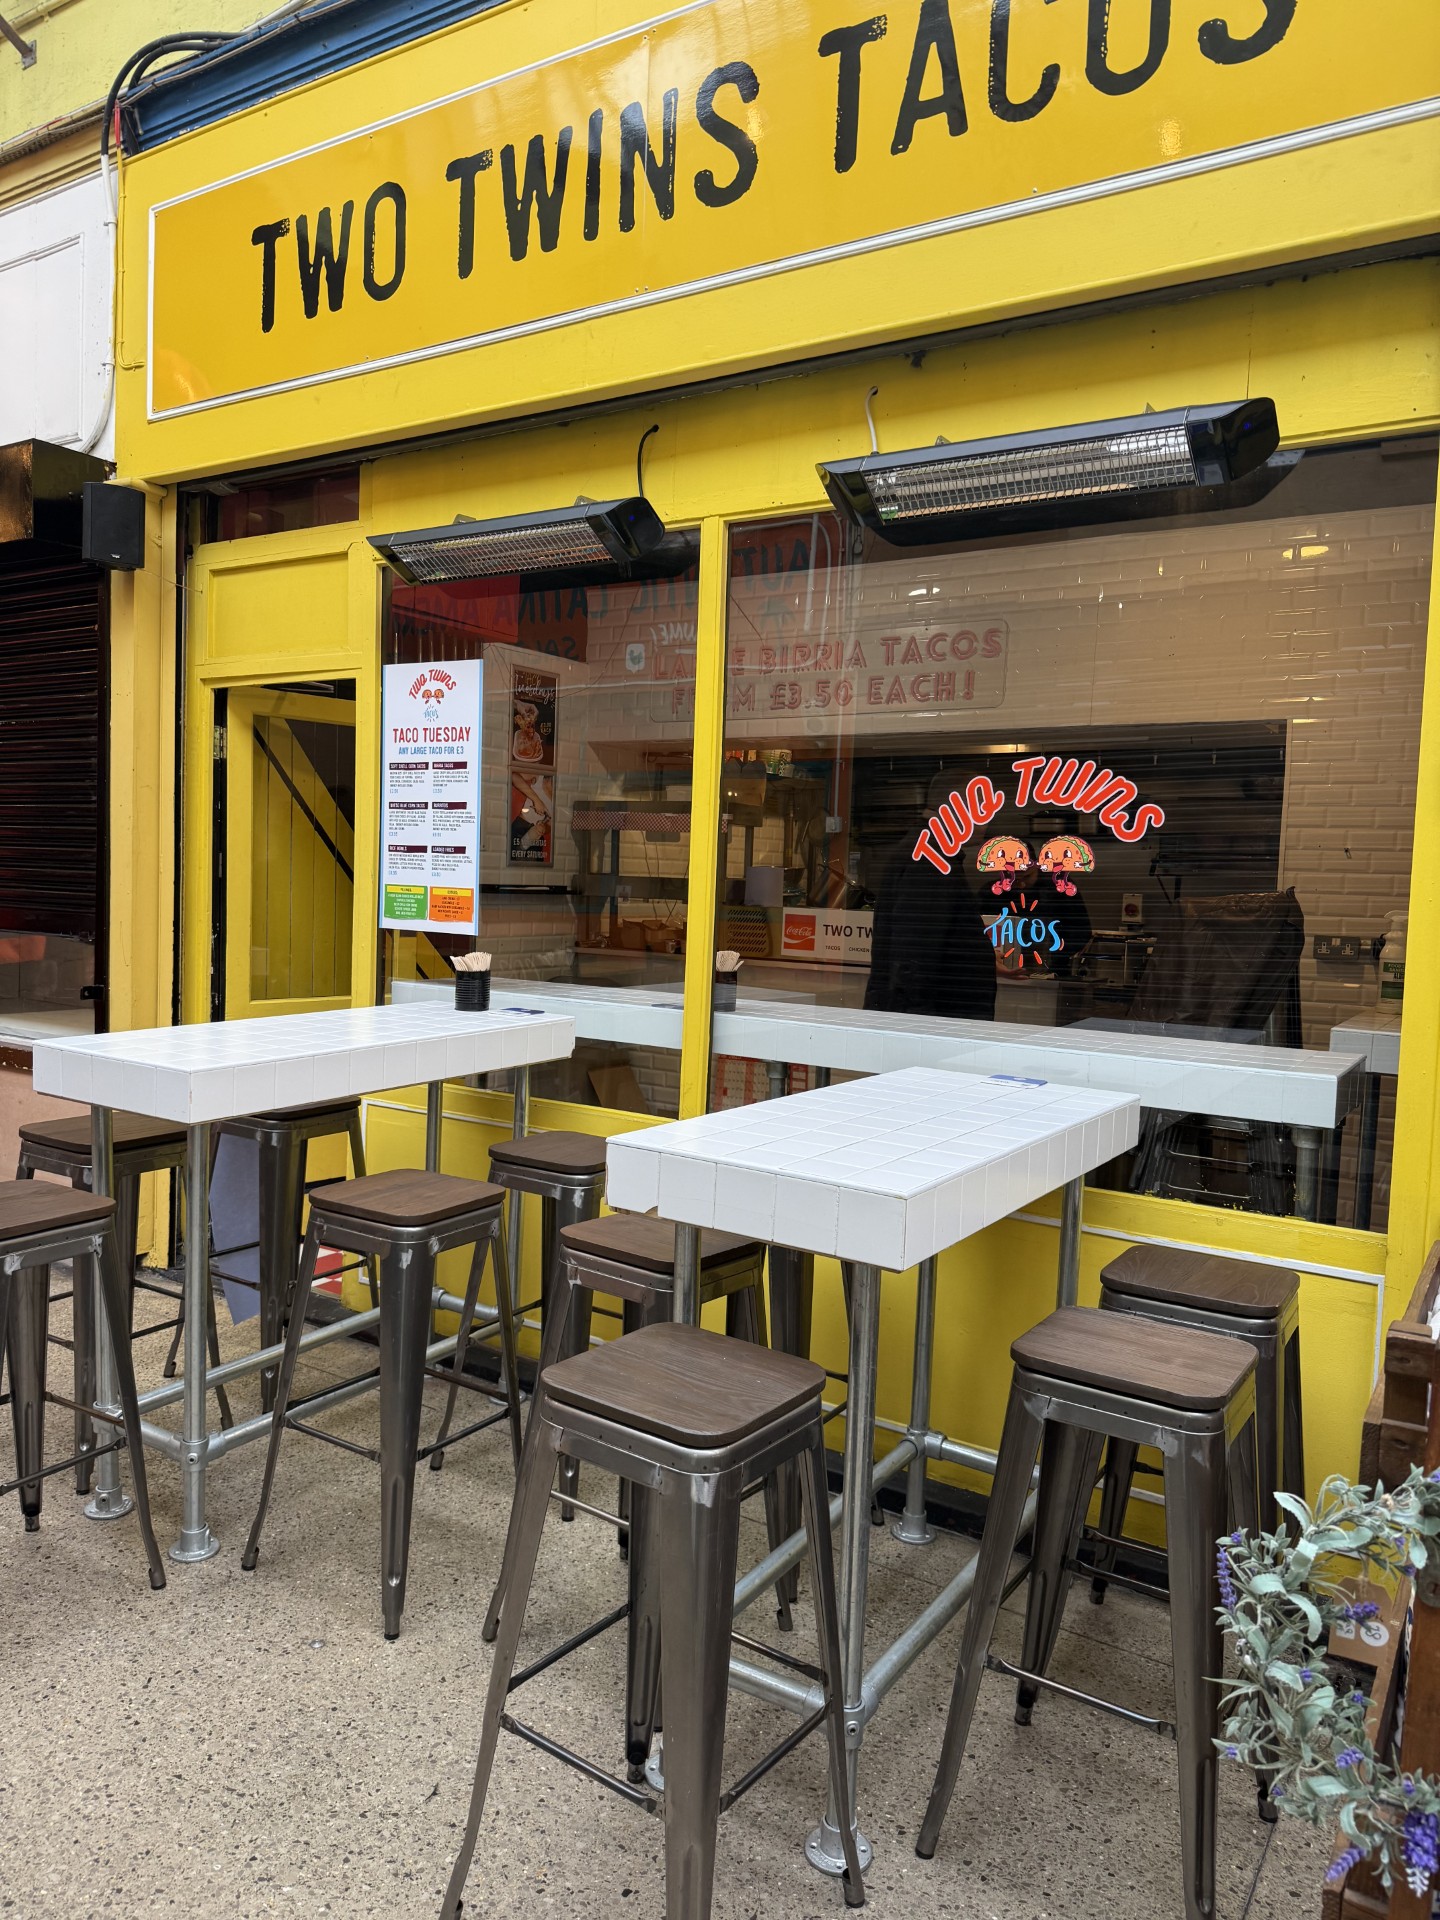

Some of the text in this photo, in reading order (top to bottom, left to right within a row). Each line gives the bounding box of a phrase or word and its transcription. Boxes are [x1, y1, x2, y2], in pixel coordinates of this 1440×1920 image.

[251, 181, 407, 333] TWO
[446, 61, 760, 280] TWINS
[654, 628, 1003, 680] LAE BIRRIA TACOS
[867, 670, 977, 705] EACH!
[393, 726, 472, 743] TACO TUESDAY
[398, 747, 409, 755] ANY
[410, 746, 428, 755] LARGE
[429, 746, 443, 755] TACO
[444, 746, 455, 754] FOR
[912, 776, 1005, 875] TWO
[823, 924, 853, 938] TWO
[983, 907, 1061, 952] TACOS
